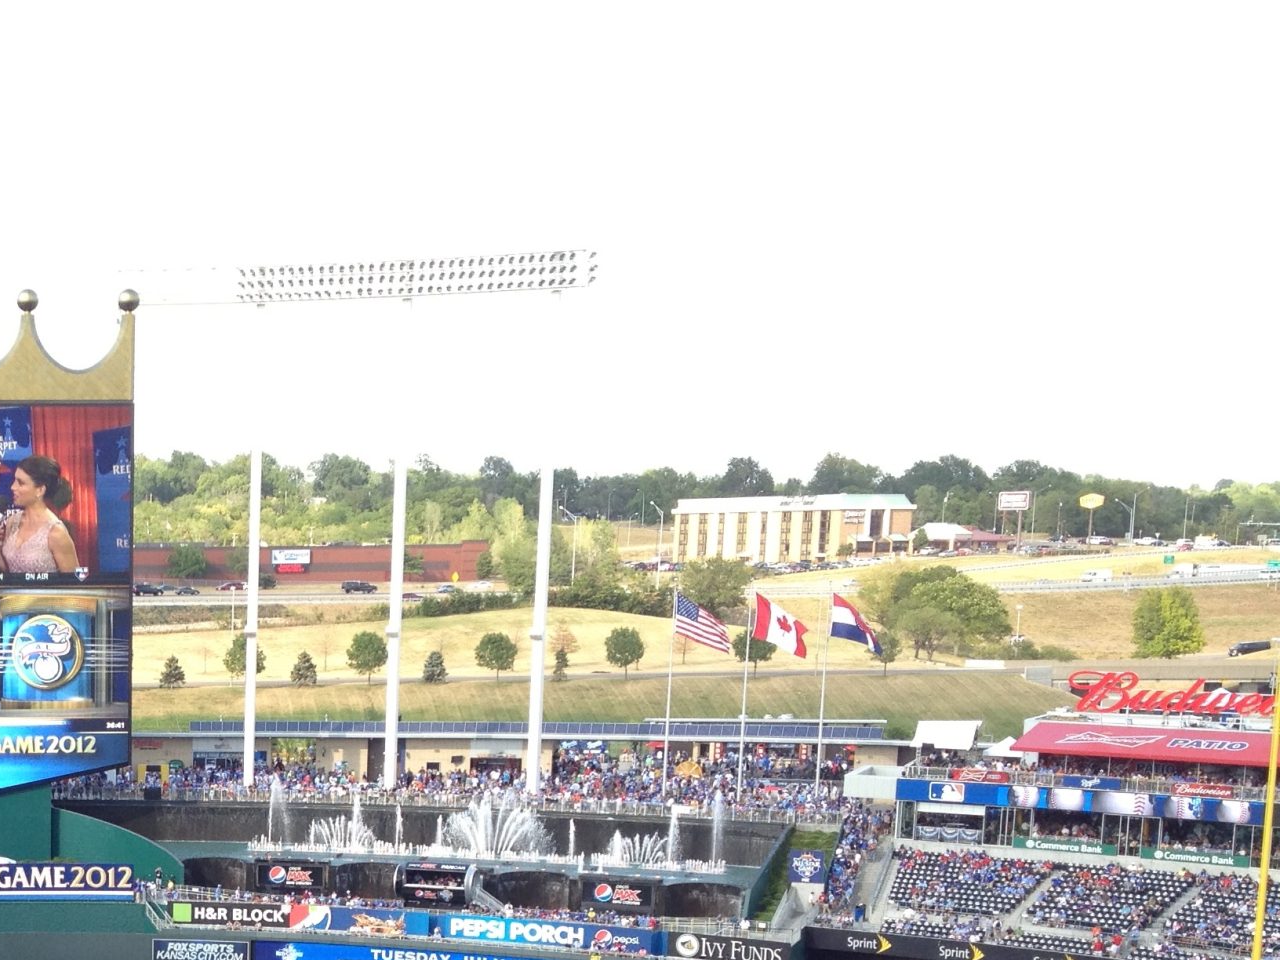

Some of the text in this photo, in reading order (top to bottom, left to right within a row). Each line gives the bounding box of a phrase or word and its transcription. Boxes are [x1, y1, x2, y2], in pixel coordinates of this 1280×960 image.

[47, 734, 97, 754] 2012
[1167, 738, 1249, 751] PATIO
[1174, 783, 1232, 796] Budweiser
[1035, 840, 1103, 854] Commerce Bank
[1164, 849, 1234, 865] Commerce Bank
[69, 866, 132, 889] 2012
[612, 889, 641, 901] MAX
[194, 906, 284, 924] H&R BLOCK
[450, 918, 584, 946] PEPSI PORCH
[612, 936, 640, 945] pepsi
[700, 937, 726, 960] IVY
[847, 936, 878, 953] Sprint
